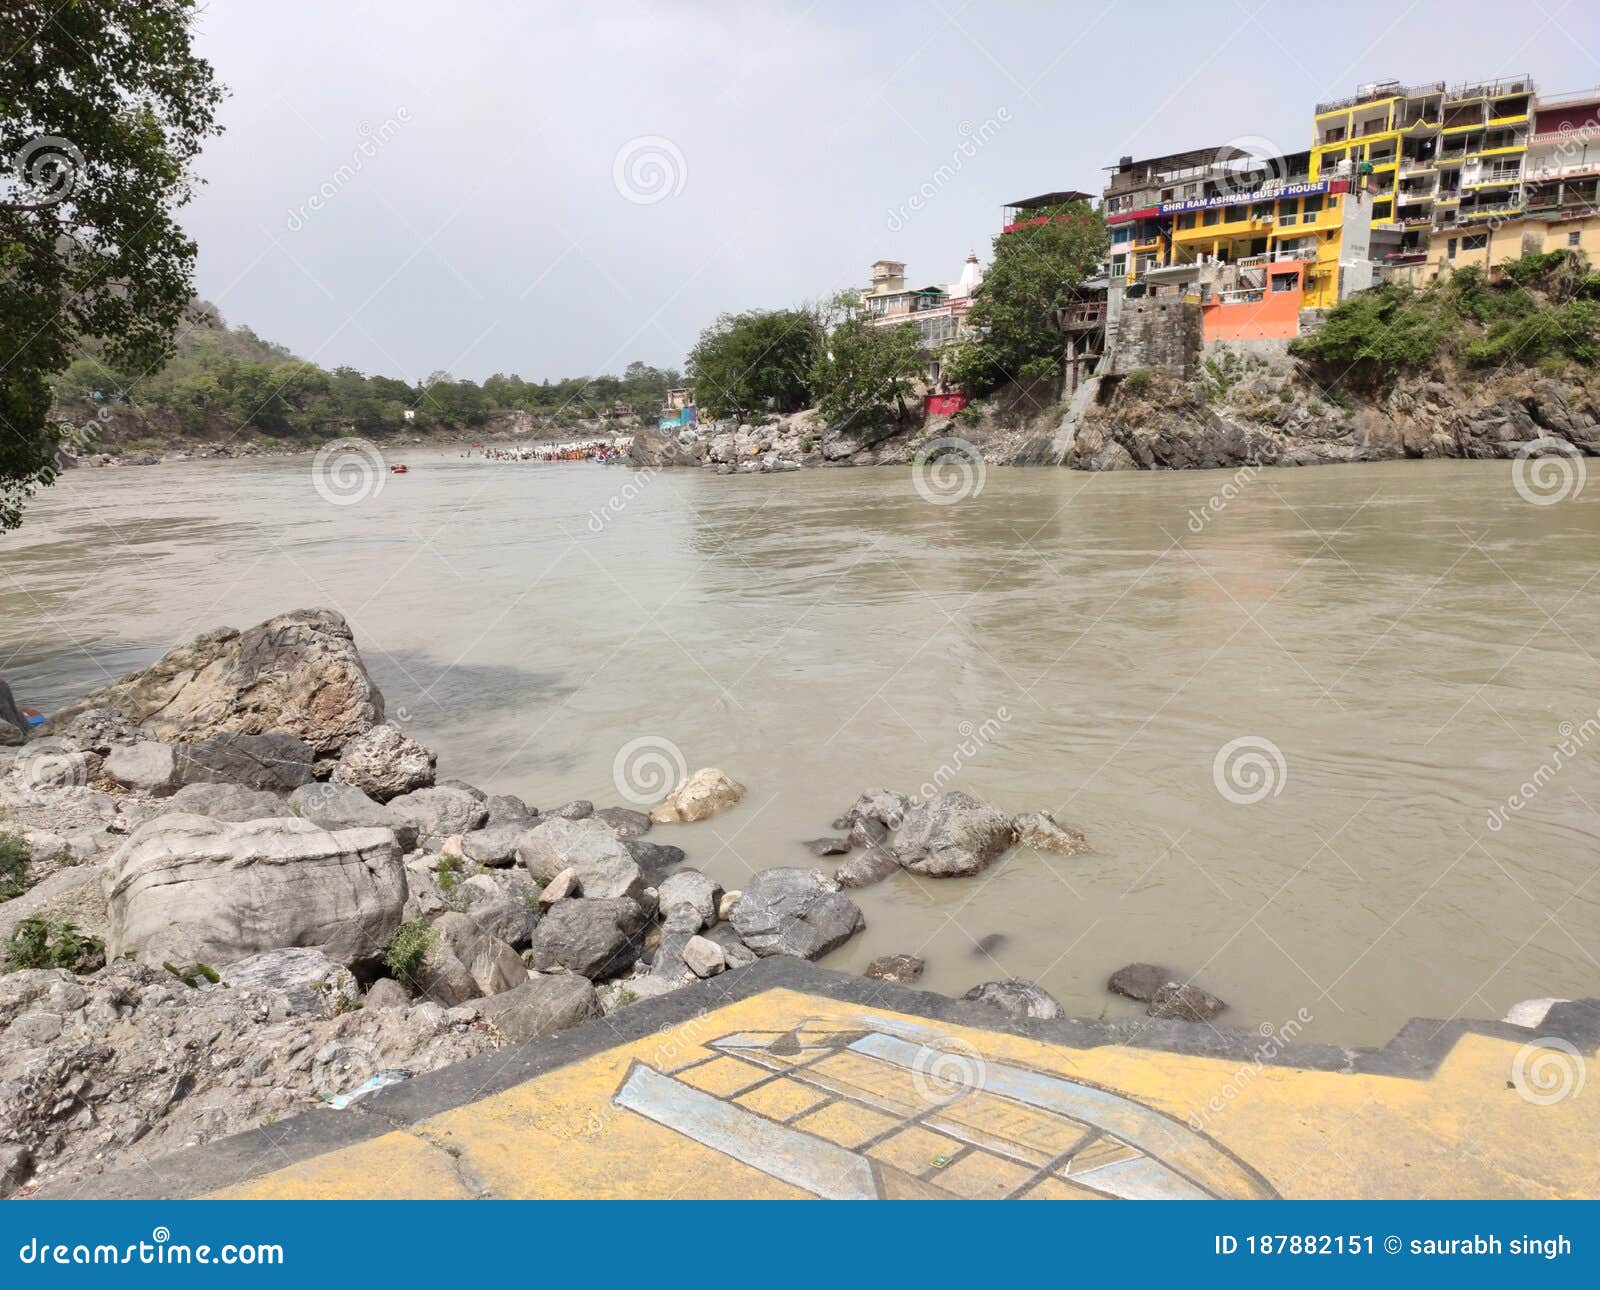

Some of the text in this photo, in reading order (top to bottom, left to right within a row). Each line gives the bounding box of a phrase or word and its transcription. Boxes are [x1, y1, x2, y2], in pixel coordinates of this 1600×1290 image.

[1162, 201, 1185, 212] SHRI
[1186, 198, 1208, 208] RAM
[1209, 193, 1250, 205] ASHRAM
[1252, 187, 1286, 199] GUEST
[1288, 182, 1324, 195] HOUSE
